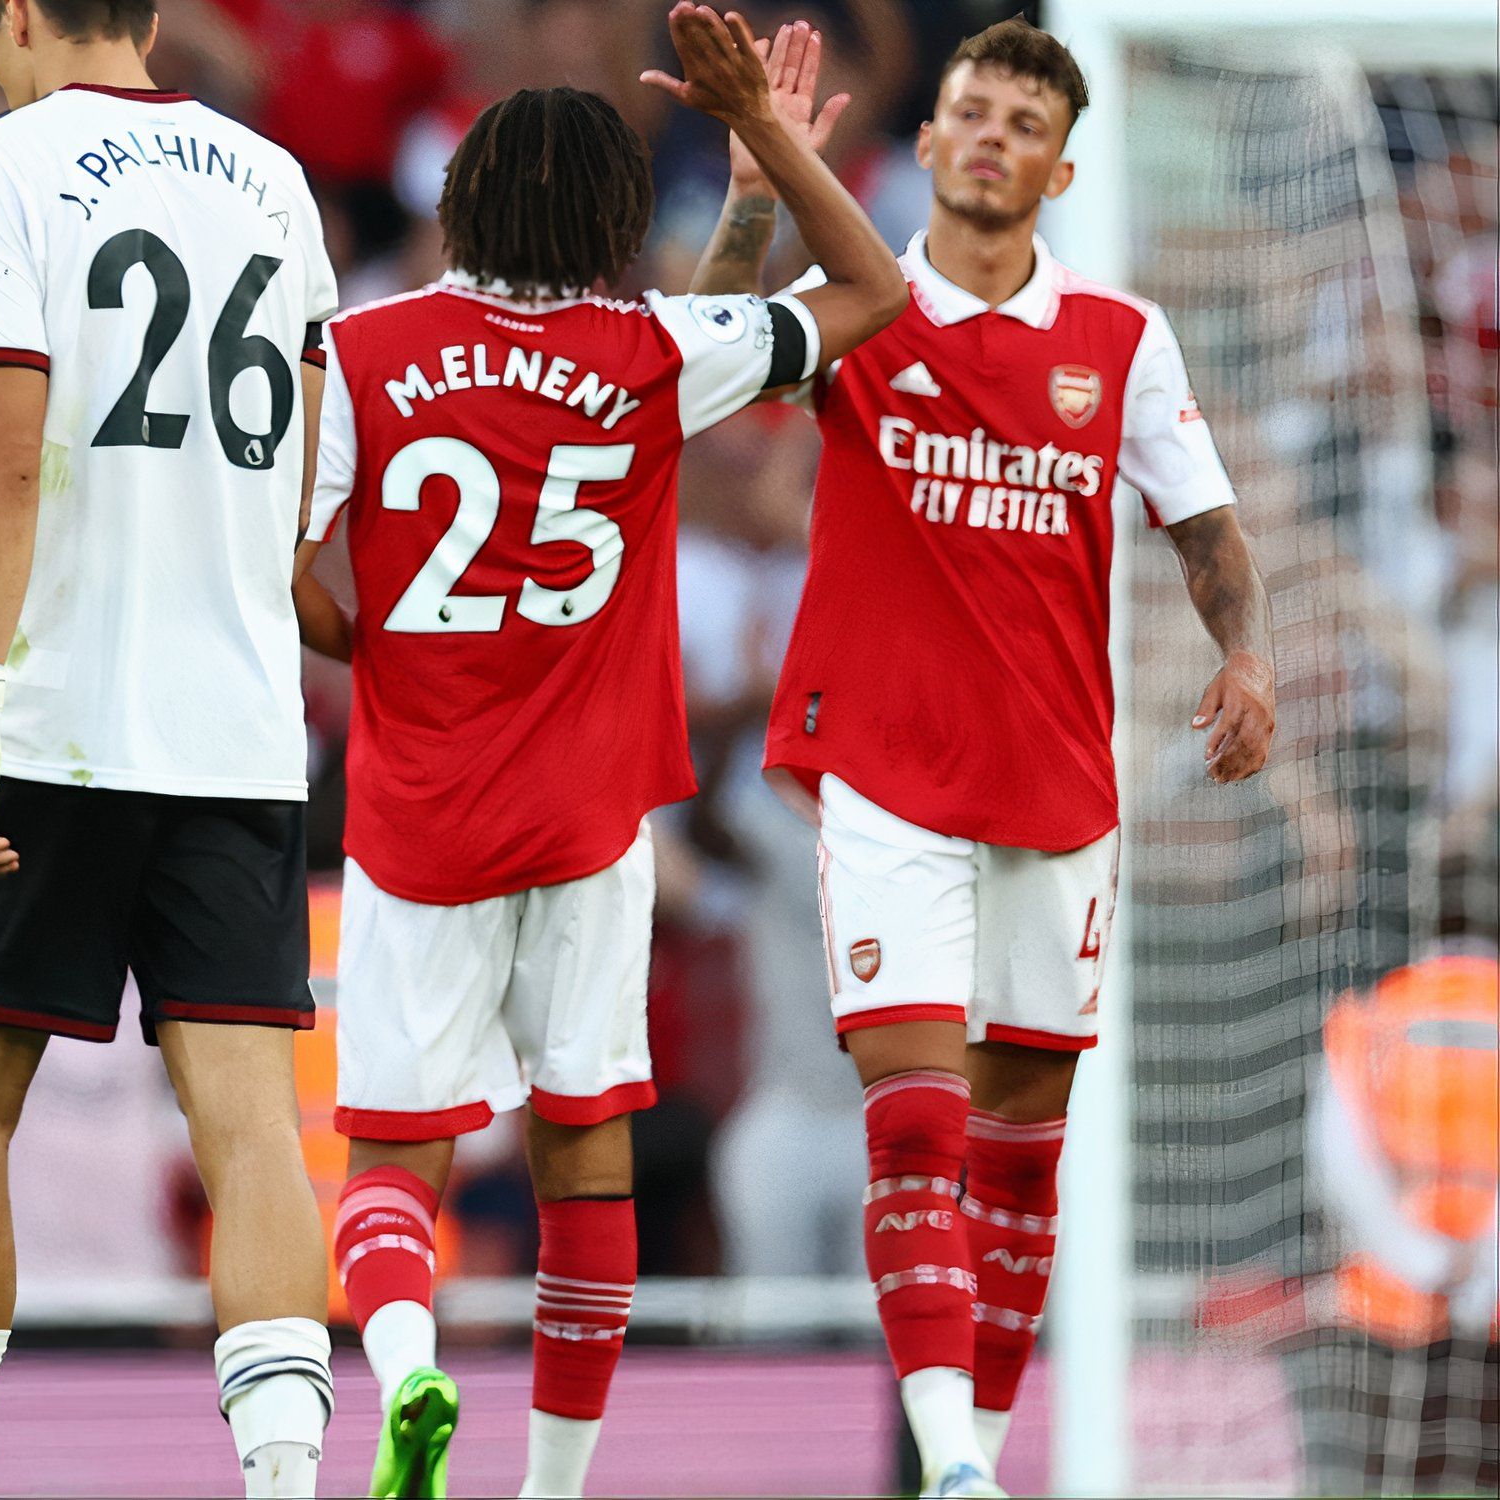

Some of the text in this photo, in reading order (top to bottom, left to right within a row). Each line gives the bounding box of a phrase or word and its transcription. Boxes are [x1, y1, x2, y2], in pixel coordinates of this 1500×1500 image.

[87, 228, 295, 470] 26
[384, 343, 640, 430] M.ELNENY
[878, 415, 1104, 497] Emirates
[382, 436, 636, 633] 25
[910, 478, 1070, 536] FLY BETTER
